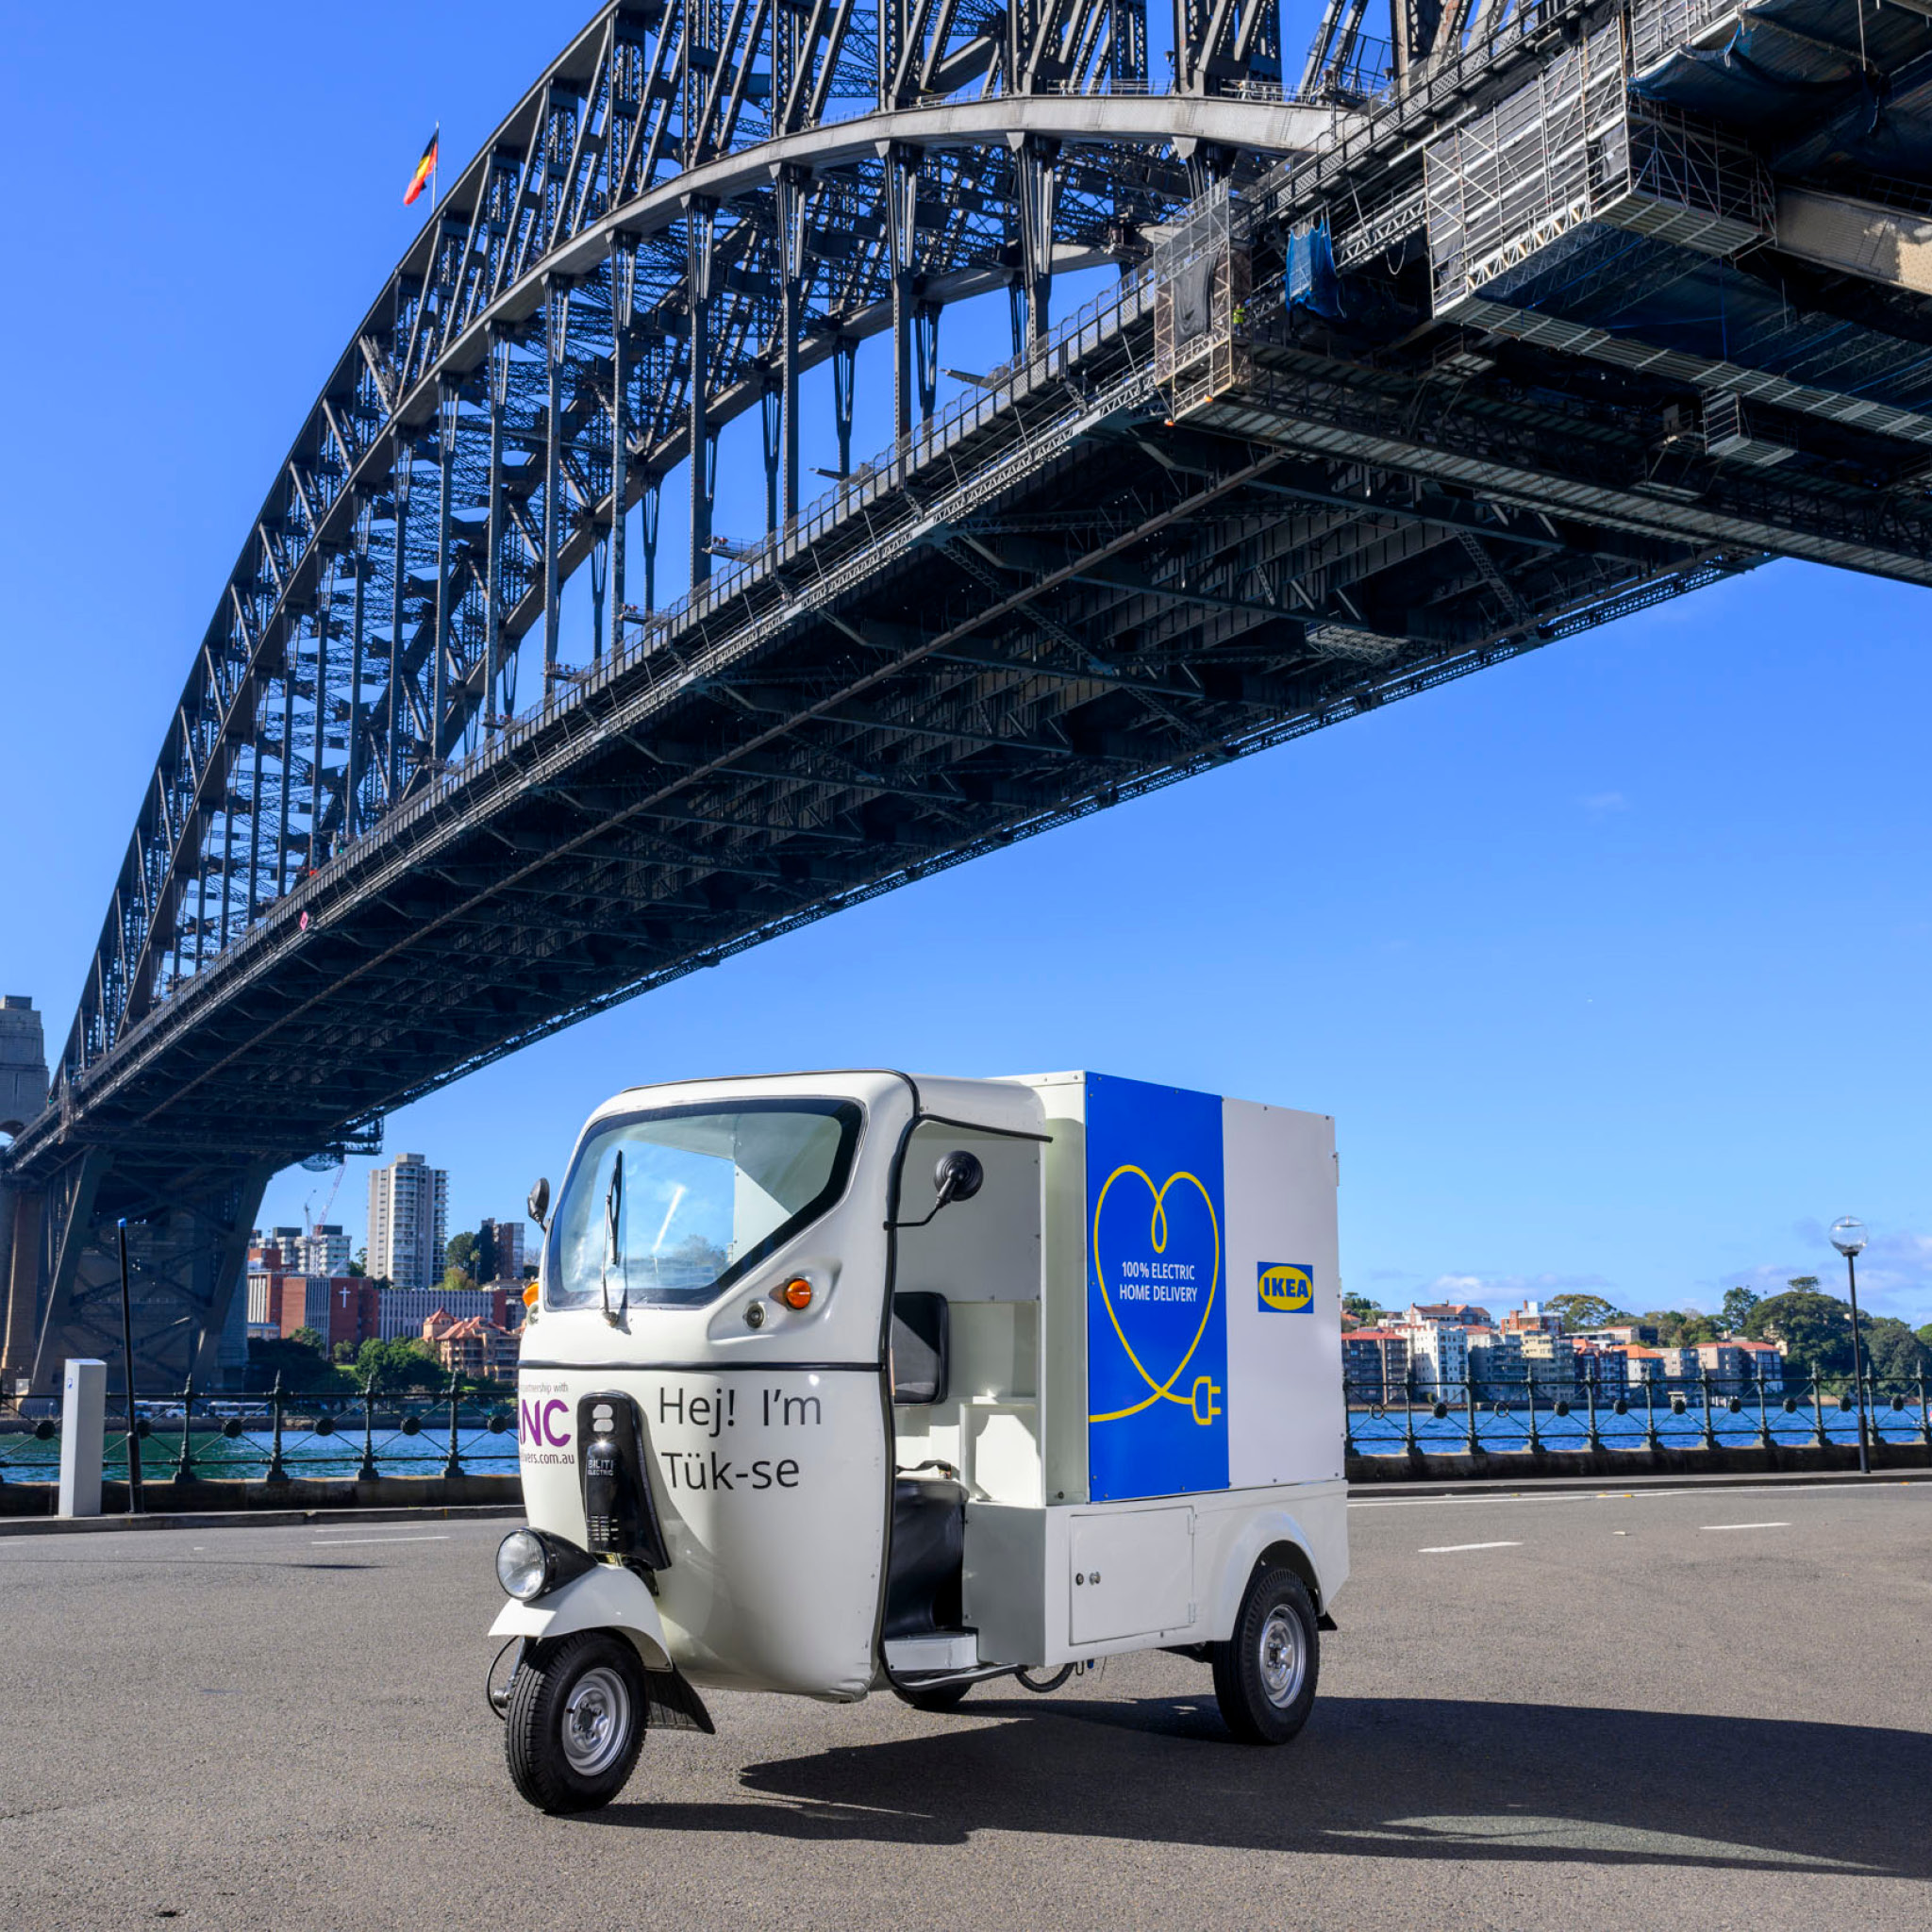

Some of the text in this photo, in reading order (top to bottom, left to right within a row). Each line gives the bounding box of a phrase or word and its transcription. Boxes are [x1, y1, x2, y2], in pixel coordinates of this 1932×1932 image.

[1122, 1261, 1195, 1280] 100% ELECTRIC
[1119, 1284, 1198, 1302] HOME DELIVERY
[1263, 1276, 1309, 1298] IKEA
[519, 1399, 572, 1447] NC
[659, 1387, 735, 1438] Hej!
[660, 1451, 800, 1491] Tük-se
